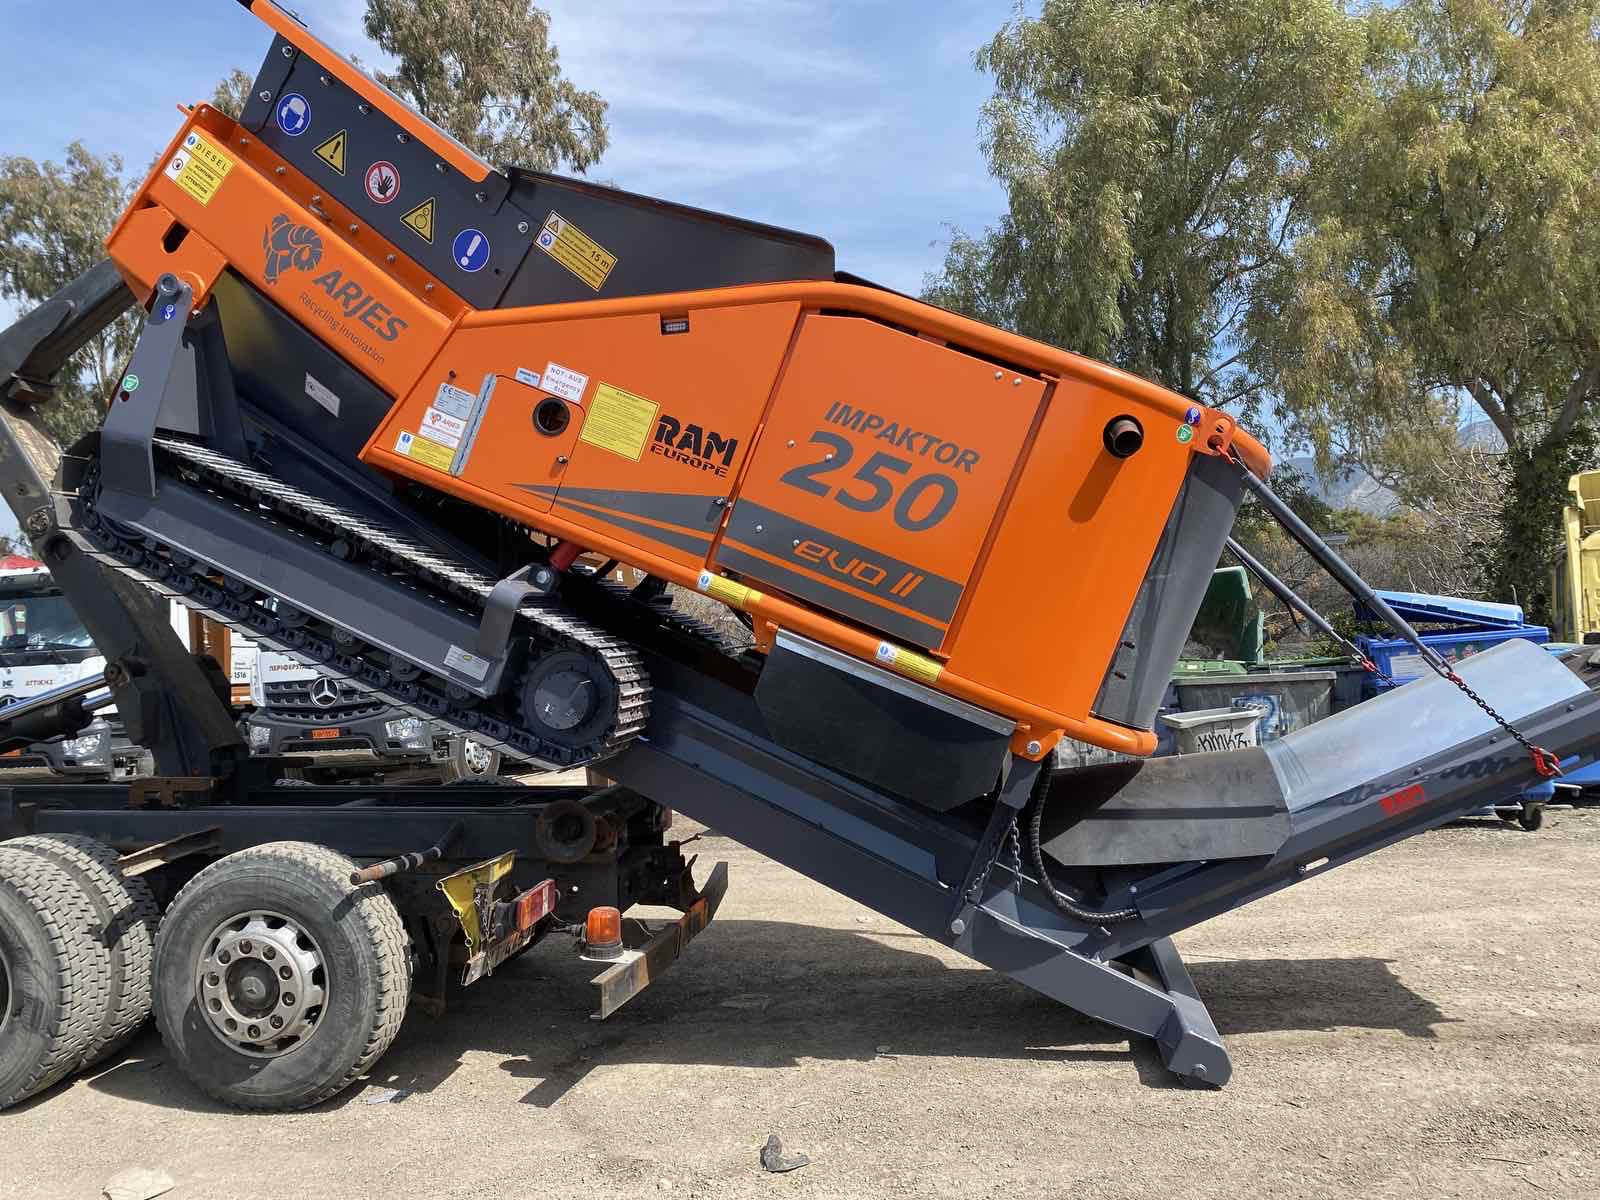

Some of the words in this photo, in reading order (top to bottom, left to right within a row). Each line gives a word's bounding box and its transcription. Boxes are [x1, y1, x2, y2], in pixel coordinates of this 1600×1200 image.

[195, 143, 226, 171] DIESEL
[590, 250, 602, 262] 15
[600, 259, 610, 269] m
[299, 291, 341, 332] Recycling
[340, 322, 385, 366] innovation
[311, 269, 409, 342] ARJES
[650, 442, 729, 479] EUROPE
[654, 414, 738, 468] RAM
[823, 400, 981, 473] IMPAKTOR
[779, 430, 959, 532] 250
[793, 539, 888, 587] evo
[889, 571, 925, 598] II
[234, 671, 247, 679] 1516
